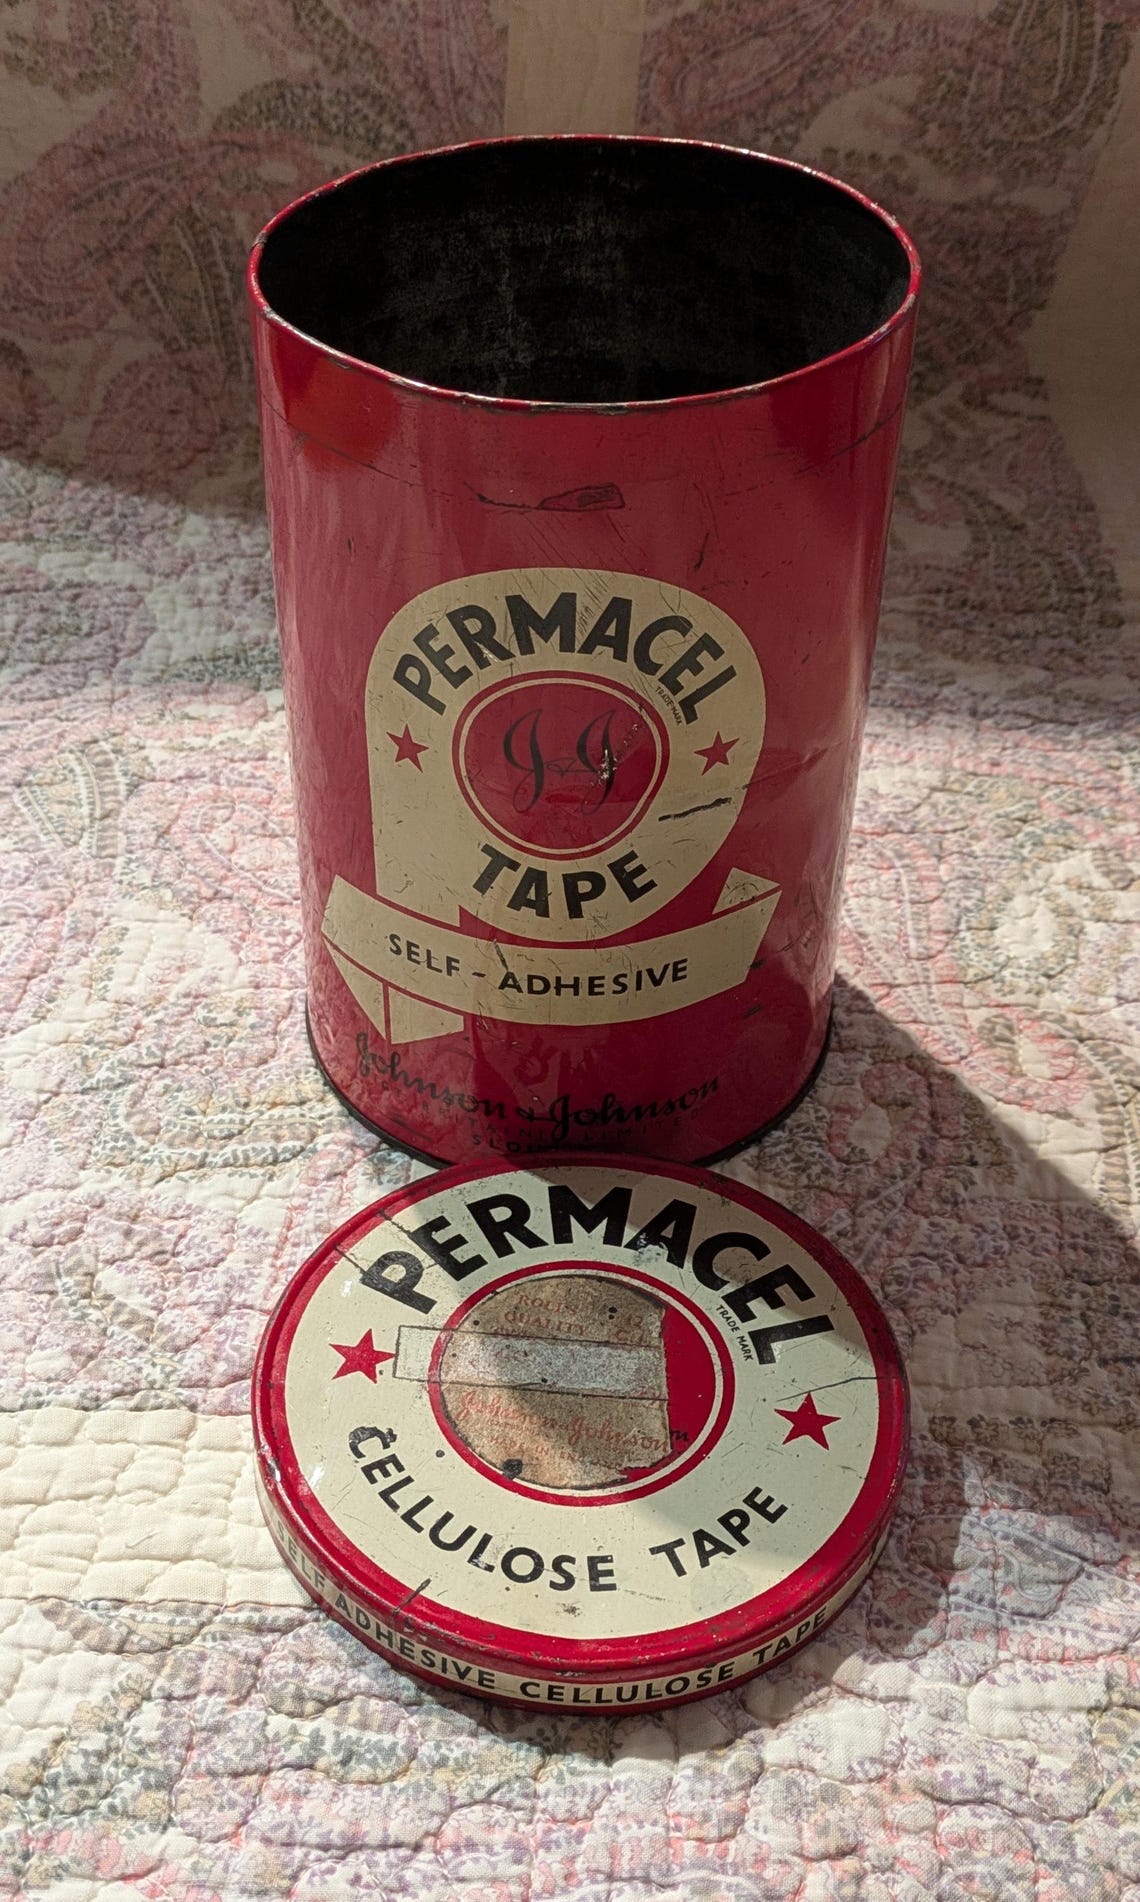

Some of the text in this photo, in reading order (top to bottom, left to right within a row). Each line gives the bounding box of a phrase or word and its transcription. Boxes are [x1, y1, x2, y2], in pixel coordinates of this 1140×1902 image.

[393, 592, 738, 725] PERMACEL
[470, 843, 659, 920] TAPE
[388, 933, 460, 976] SELF
[498, 958, 689, 998] ADHESIVE
[356, 1032, 509, 1120] Johnson
[550, 1076, 720, 1141] Johnson
[358, 1184, 838, 1366] PERMACEL
[715, 1304, 754, 1361] TRADE MARK
[348, 1425, 618, 1593] CELLULOSE
[649, 1487, 789, 1579] TAPE
[276, 1519, 828, 1705] SELF ADHESIVE CELLULOSE TAPE
